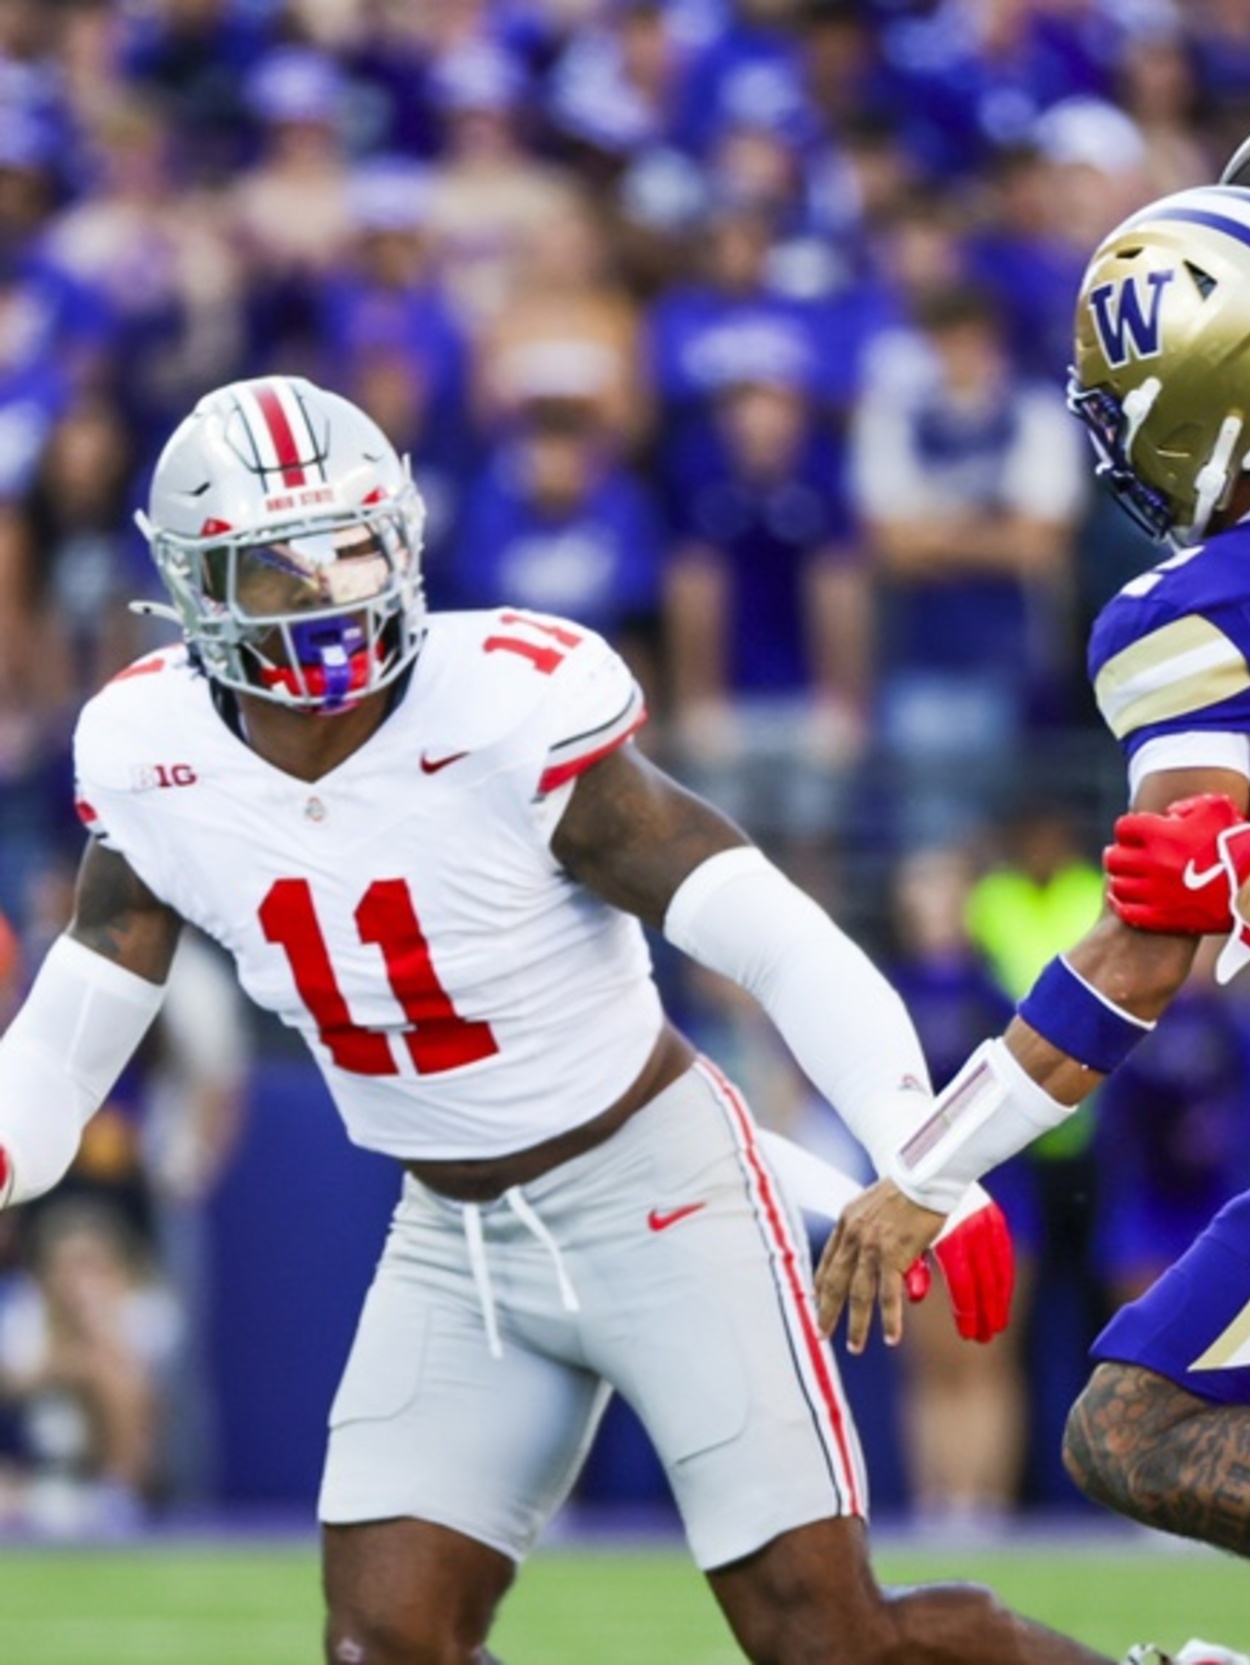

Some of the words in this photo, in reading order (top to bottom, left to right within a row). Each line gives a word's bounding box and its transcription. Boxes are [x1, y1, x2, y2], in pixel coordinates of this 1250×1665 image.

[1090, 268, 1175, 369] W
[483, 613, 583, 676] 11
[257, 877, 501, 1077] 11
